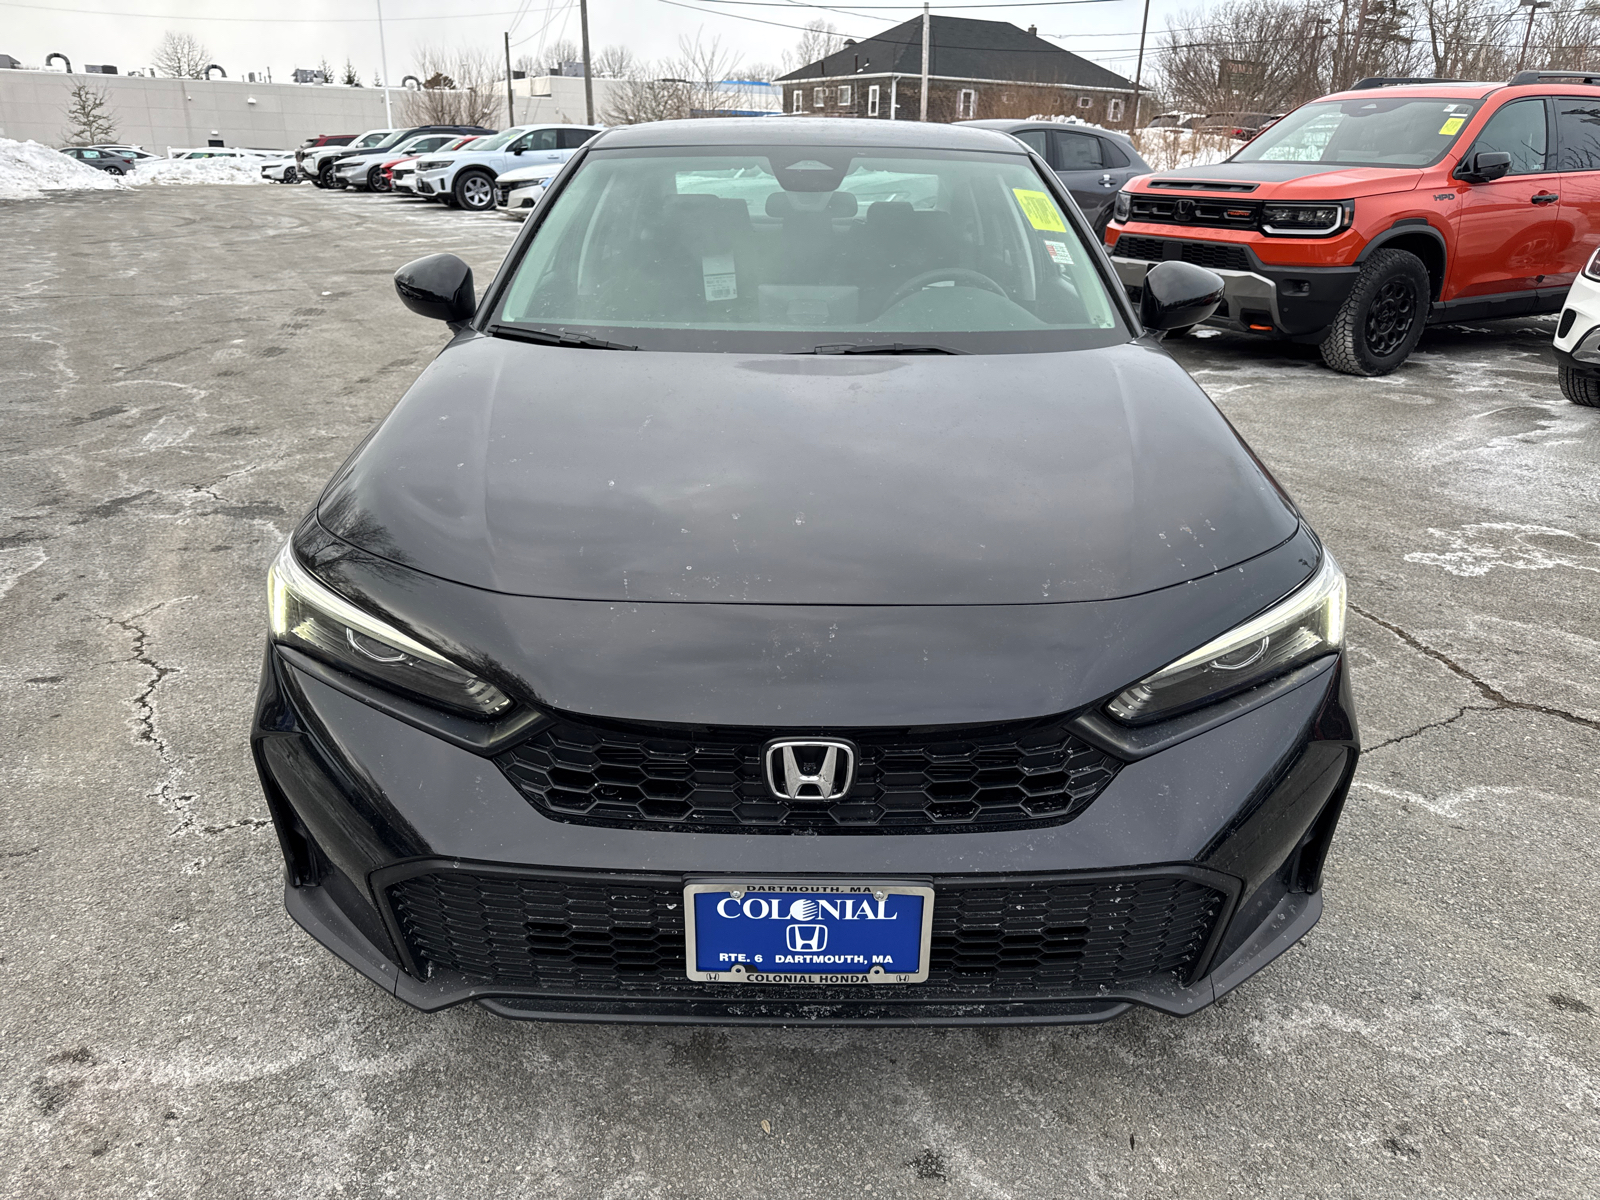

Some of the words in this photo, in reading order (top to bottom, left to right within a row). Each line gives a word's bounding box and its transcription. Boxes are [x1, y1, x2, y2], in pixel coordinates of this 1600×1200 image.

[1433, 193, 1455, 202] HPD
[716, 897, 898, 921] COLONIAL
[719, 952, 751, 962] RTE.
[754, 954, 763, 963] 6
[775, 954, 868, 965] DARTMOUTH,
[872, 955, 893, 963] MA
[746, 974, 816, 983] COLONIAL
[819, 975, 869, 983] HONDA
